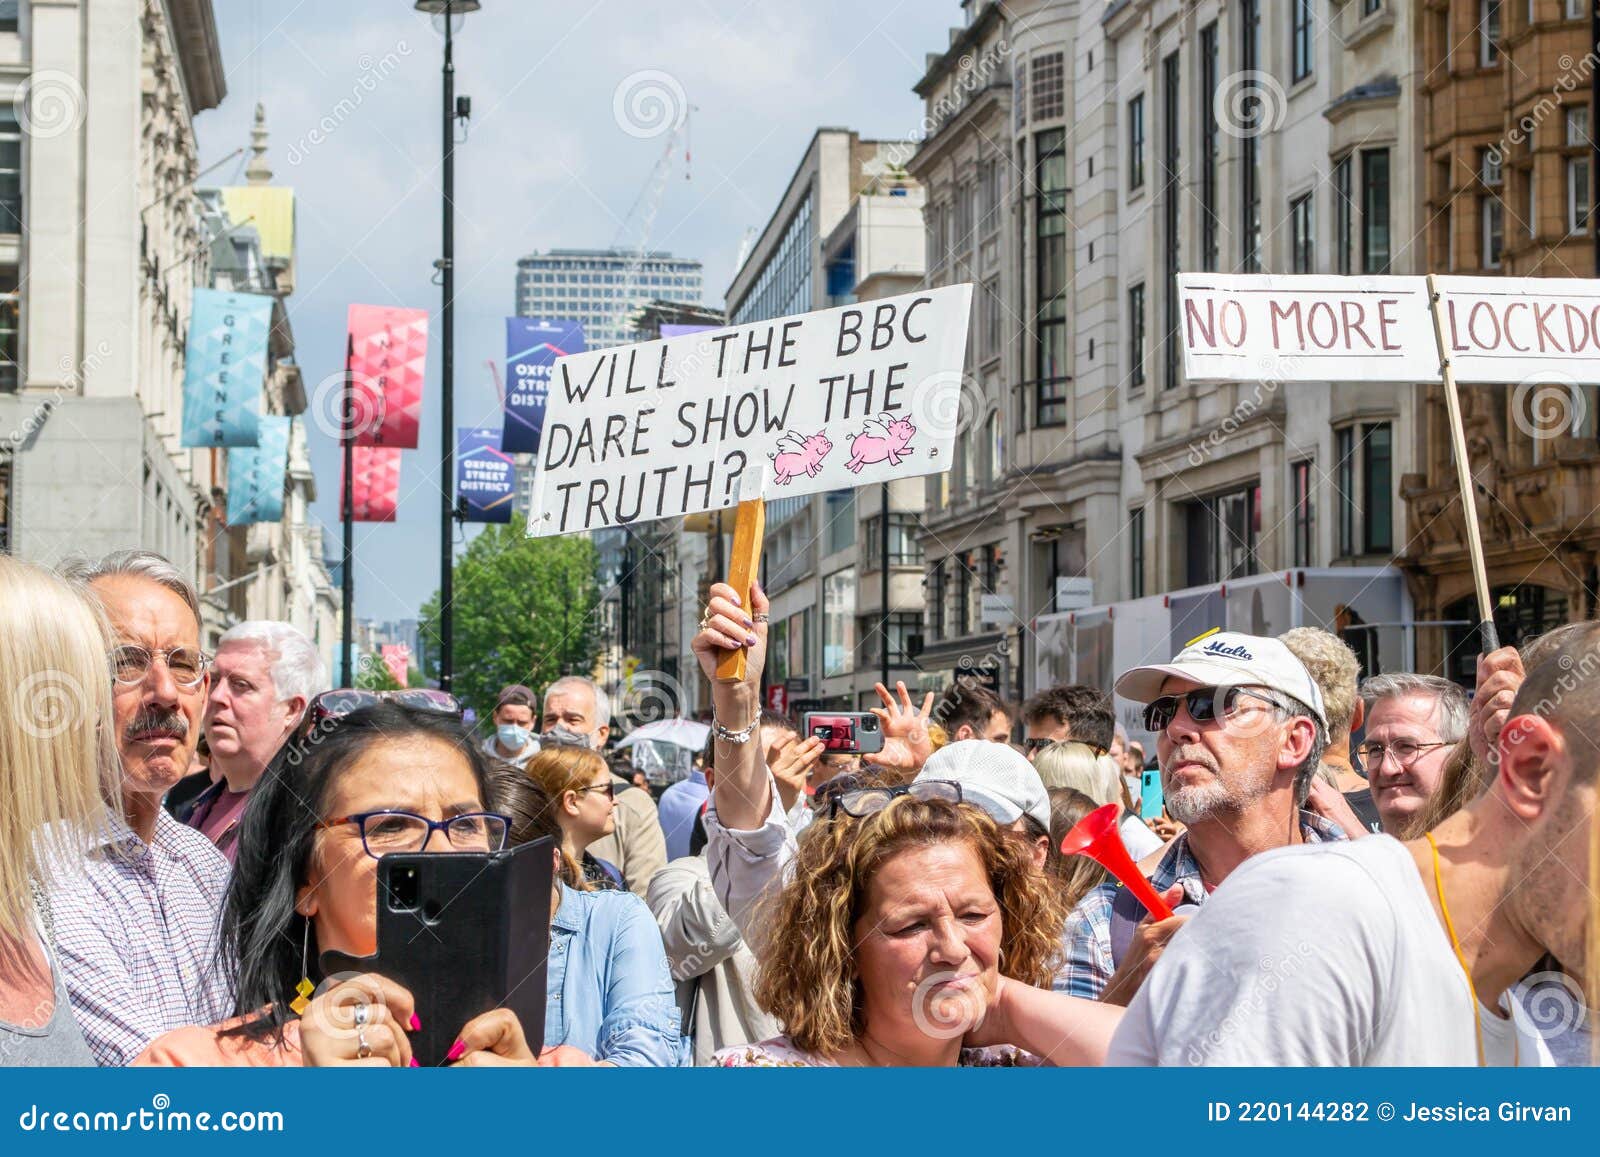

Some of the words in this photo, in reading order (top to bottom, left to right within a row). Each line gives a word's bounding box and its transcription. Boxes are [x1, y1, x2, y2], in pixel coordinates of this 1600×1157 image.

[1184, 298, 1247, 348] NO
[1270, 299, 1402, 351] MORE
[561, 345, 677, 404] WILL
[712, 321, 803, 378] THE
[836, 298, 932, 357] BBC
[213, 314, 235, 442] GREENER
[515, 363, 553, 378] OXFO
[517, 379, 550, 392] STR
[511, 393, 545, 407] DIST
[544, 408, 656, 471] DARE
[672, 384, 795, 448] SHOW
[819, 363, 908, 423] THE
[463, 459, 509, 472] OXFORD
[465, 470, 507, 482] STREET
[460, 480, 511, 492] DISTRICT
[557, 450, 747, 532] TRUTH?
[1203, 640, 1254, 661] Malta
